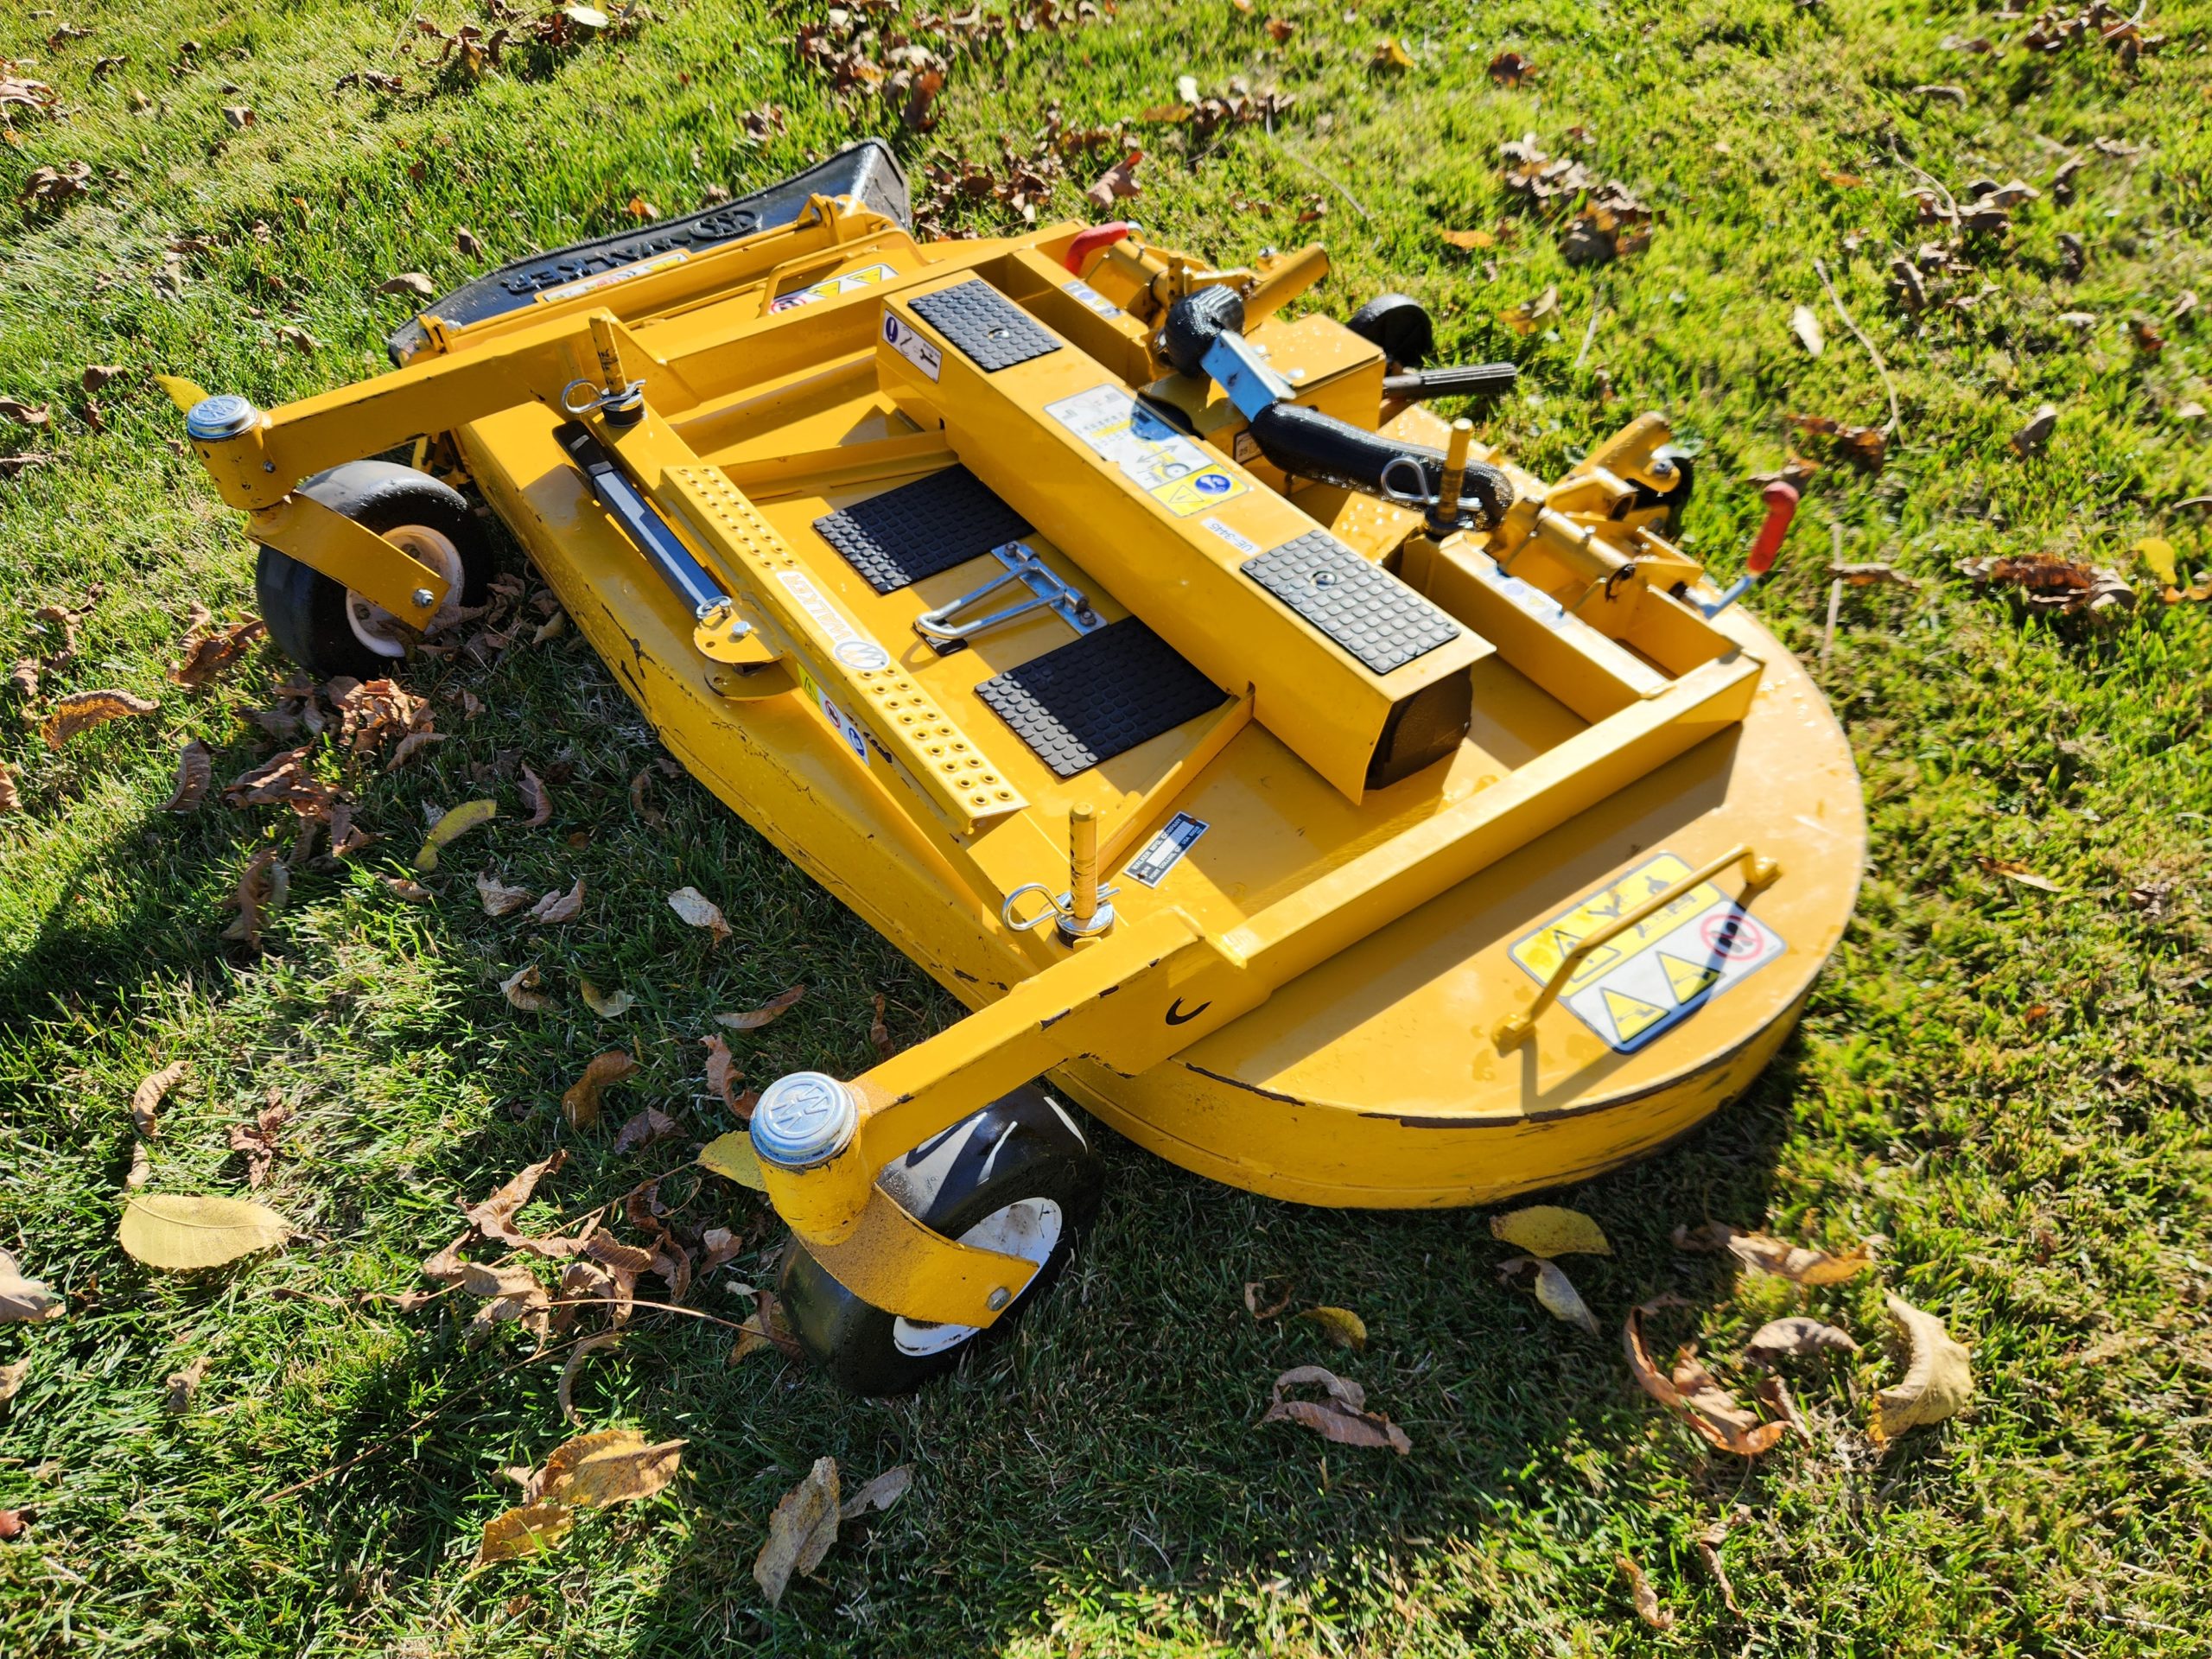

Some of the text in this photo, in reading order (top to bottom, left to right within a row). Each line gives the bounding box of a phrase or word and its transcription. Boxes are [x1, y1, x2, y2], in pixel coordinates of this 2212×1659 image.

[500, 235, 691, 296] WALKER
[1209, 523, 1254, 552] UE-3445
[782, 574, 854, 641] WALKER
[1130, 849, 1152, 870] WALKER
[1160, 817, 1183, 840] COMPANY
[1148, 868, 1161, 880] FORT
[1181, 836, 1191, 846] USA
